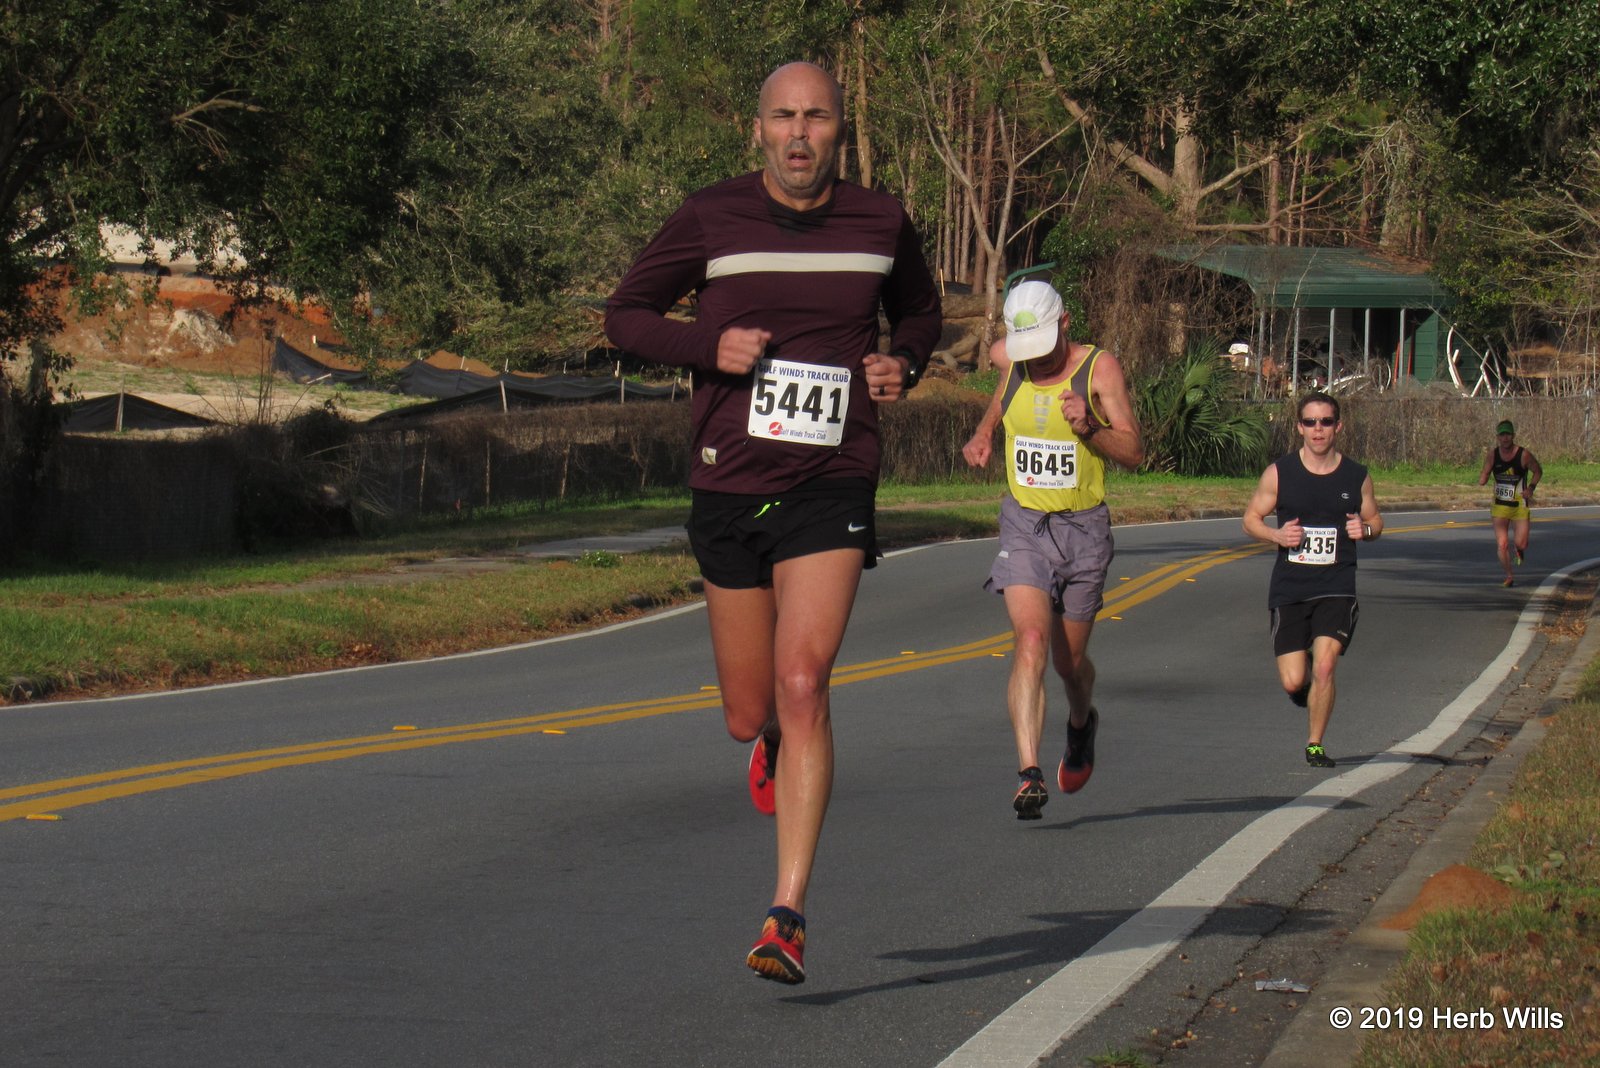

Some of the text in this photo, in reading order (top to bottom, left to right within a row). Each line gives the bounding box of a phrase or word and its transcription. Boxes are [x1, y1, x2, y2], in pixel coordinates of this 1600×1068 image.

[779, 366, 805, 378] WINDS
[807, 370, 830, 382] TRACK
[832, 373, 849, 383] CLUB
[754, 378, 842, 424] 5441
[1028, 442, 1044, 450] WINDS
[1016, 449, 1075, 477] 9645
[1495, 487, 1514, 498] 9650
[1292, 536, 1336, 555] 435
